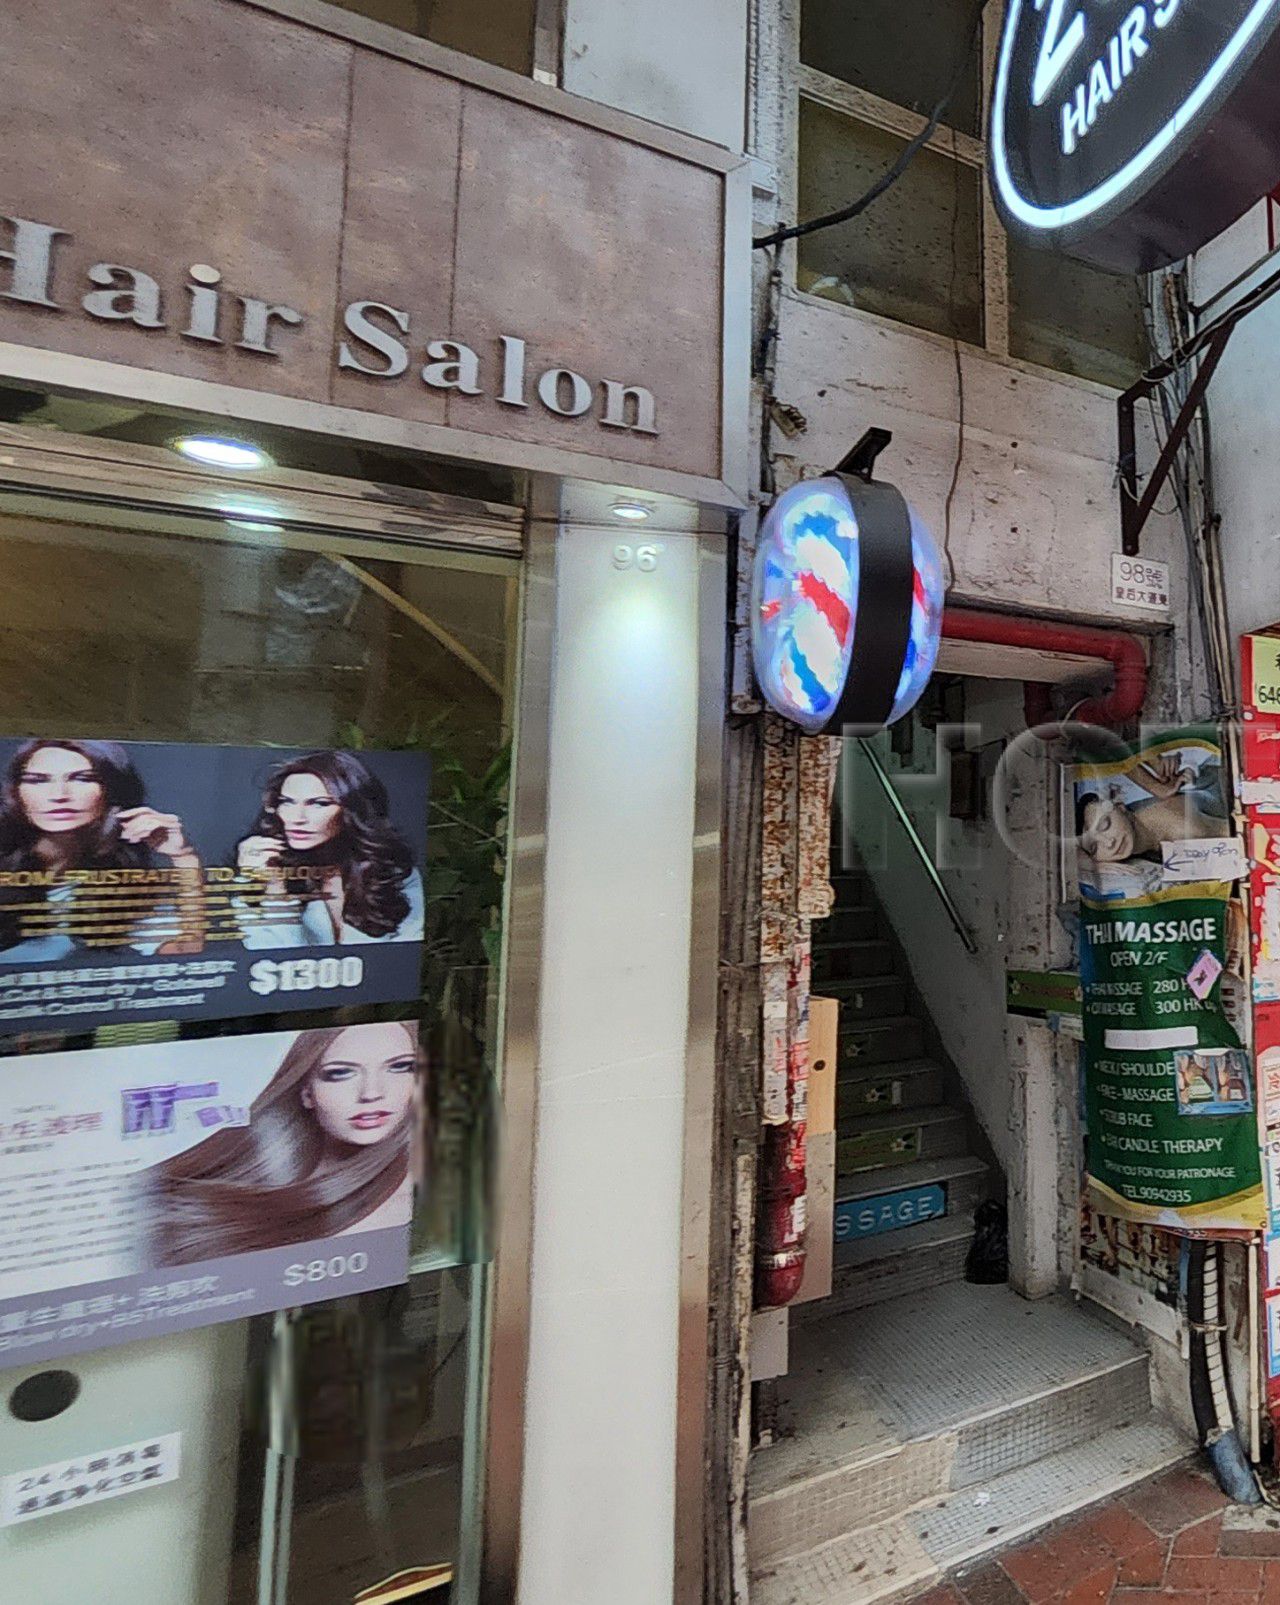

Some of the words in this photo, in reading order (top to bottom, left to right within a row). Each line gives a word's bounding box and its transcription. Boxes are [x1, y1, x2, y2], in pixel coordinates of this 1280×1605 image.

[1061, 14, 1150, 155] HAIR
[339, 300, 660, 436] Salon
[611, 544, 660, 573] 96
[1114, 917, 1217, 944] MASSAGE
[1110, 951, 1142, 967] OPEN
[1143, 951, 1169, 967] 2/F
[249, 956, 364, 996] $1300
[1152, 980, 1180, 995] 280
[1154, 1001, 1182, 1015] 300
[1127, 1113, 1154, 1128] FACE
[1118, 1138, 1160, 1153] CANDLE
[1161, 1137, 1224, 1155] THERAPY
[1177, 1166, 1237, 1180] PATRONAGE
[835, 1195, 934, 1236] SSAGE
[283, 1251, 369, 1288] $800
